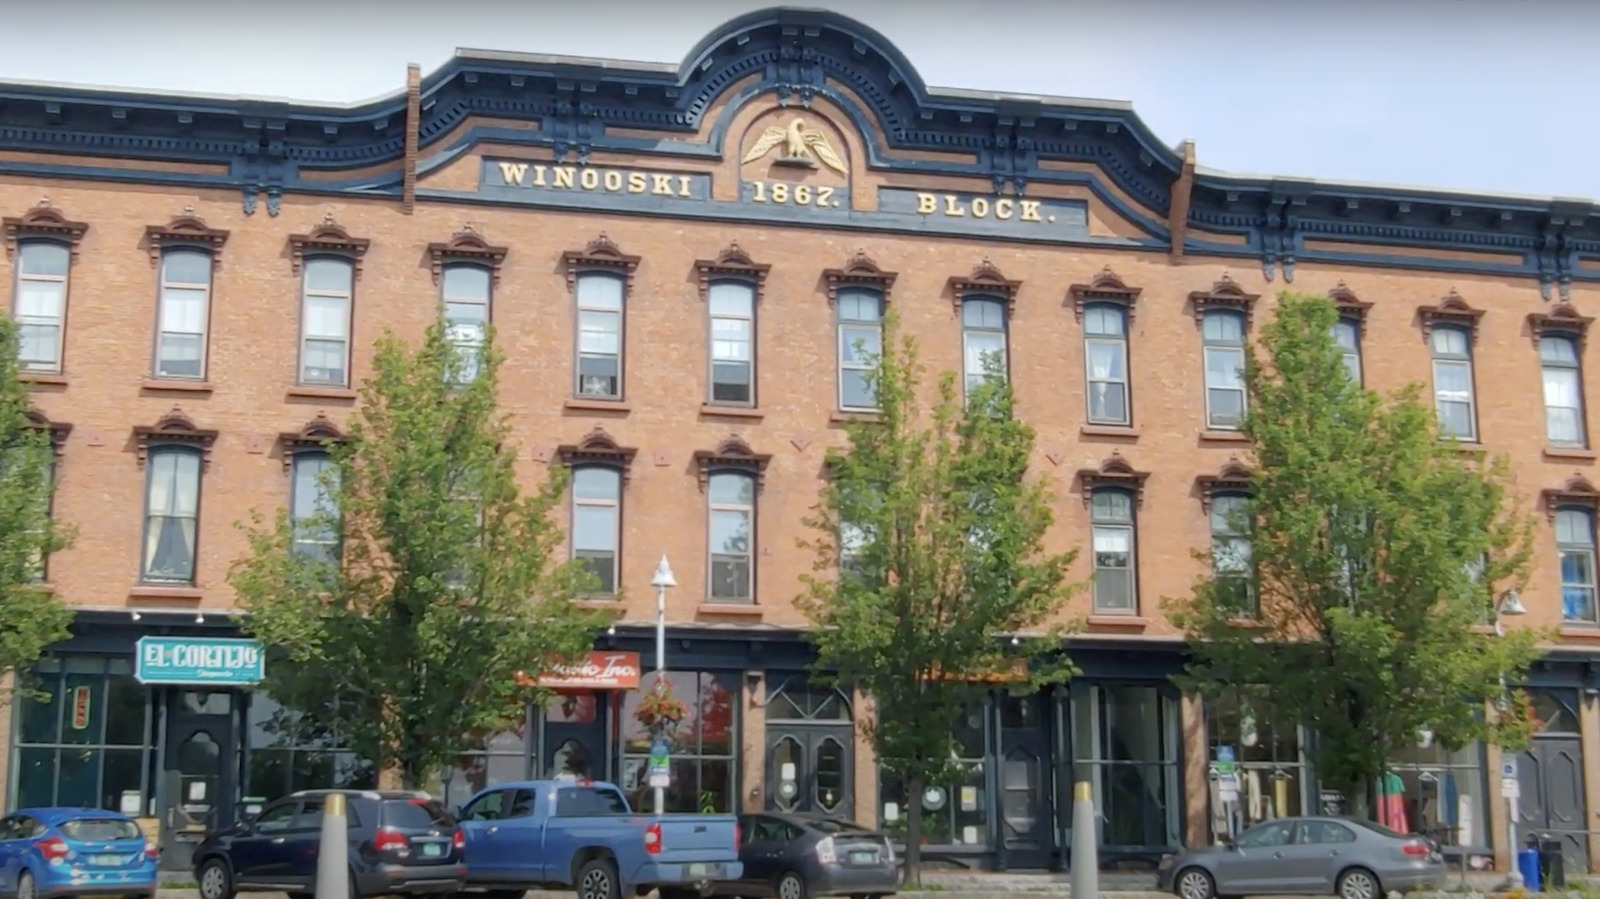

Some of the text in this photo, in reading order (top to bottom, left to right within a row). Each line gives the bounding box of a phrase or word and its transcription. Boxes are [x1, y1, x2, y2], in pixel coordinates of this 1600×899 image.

[499, 162, 692, 197] WINOOSKI
[752, 181, 840, 208] 1867.
[916, 193, 1057, 223] BLOCK.
[145, 643, 258, 669] EL CORTIJO
